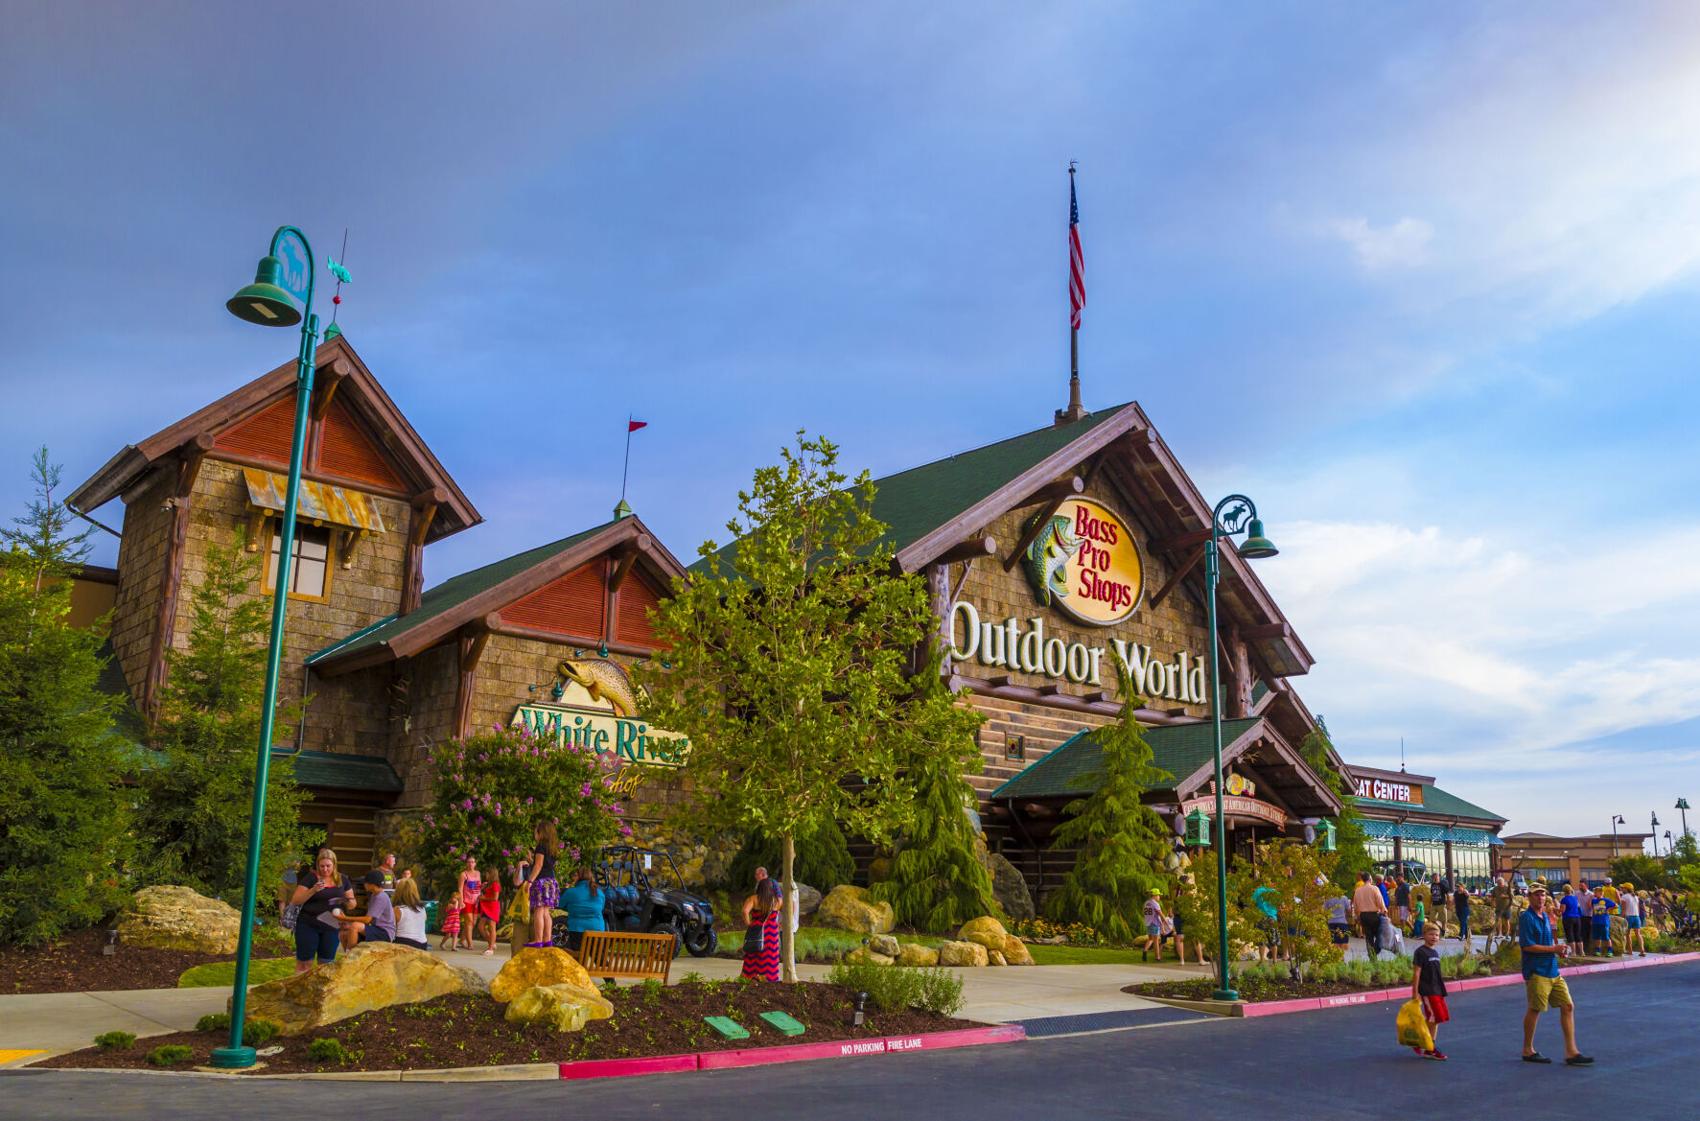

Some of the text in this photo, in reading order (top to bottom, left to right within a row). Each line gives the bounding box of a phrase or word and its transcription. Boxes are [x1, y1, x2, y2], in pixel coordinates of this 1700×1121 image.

[1075, 505, 1118, 546] Bass
[1077, 541, 1111, 573] Pro
[1078, 568, 1132, 612] Shops
[950, 600, 1207, 705] Outdoor World
[520, 709, 609, 755] White
[1373, 779, 1410, 802] CENTER
[841, 1038, 922, 1055] NO PARKING FIRE LANE
